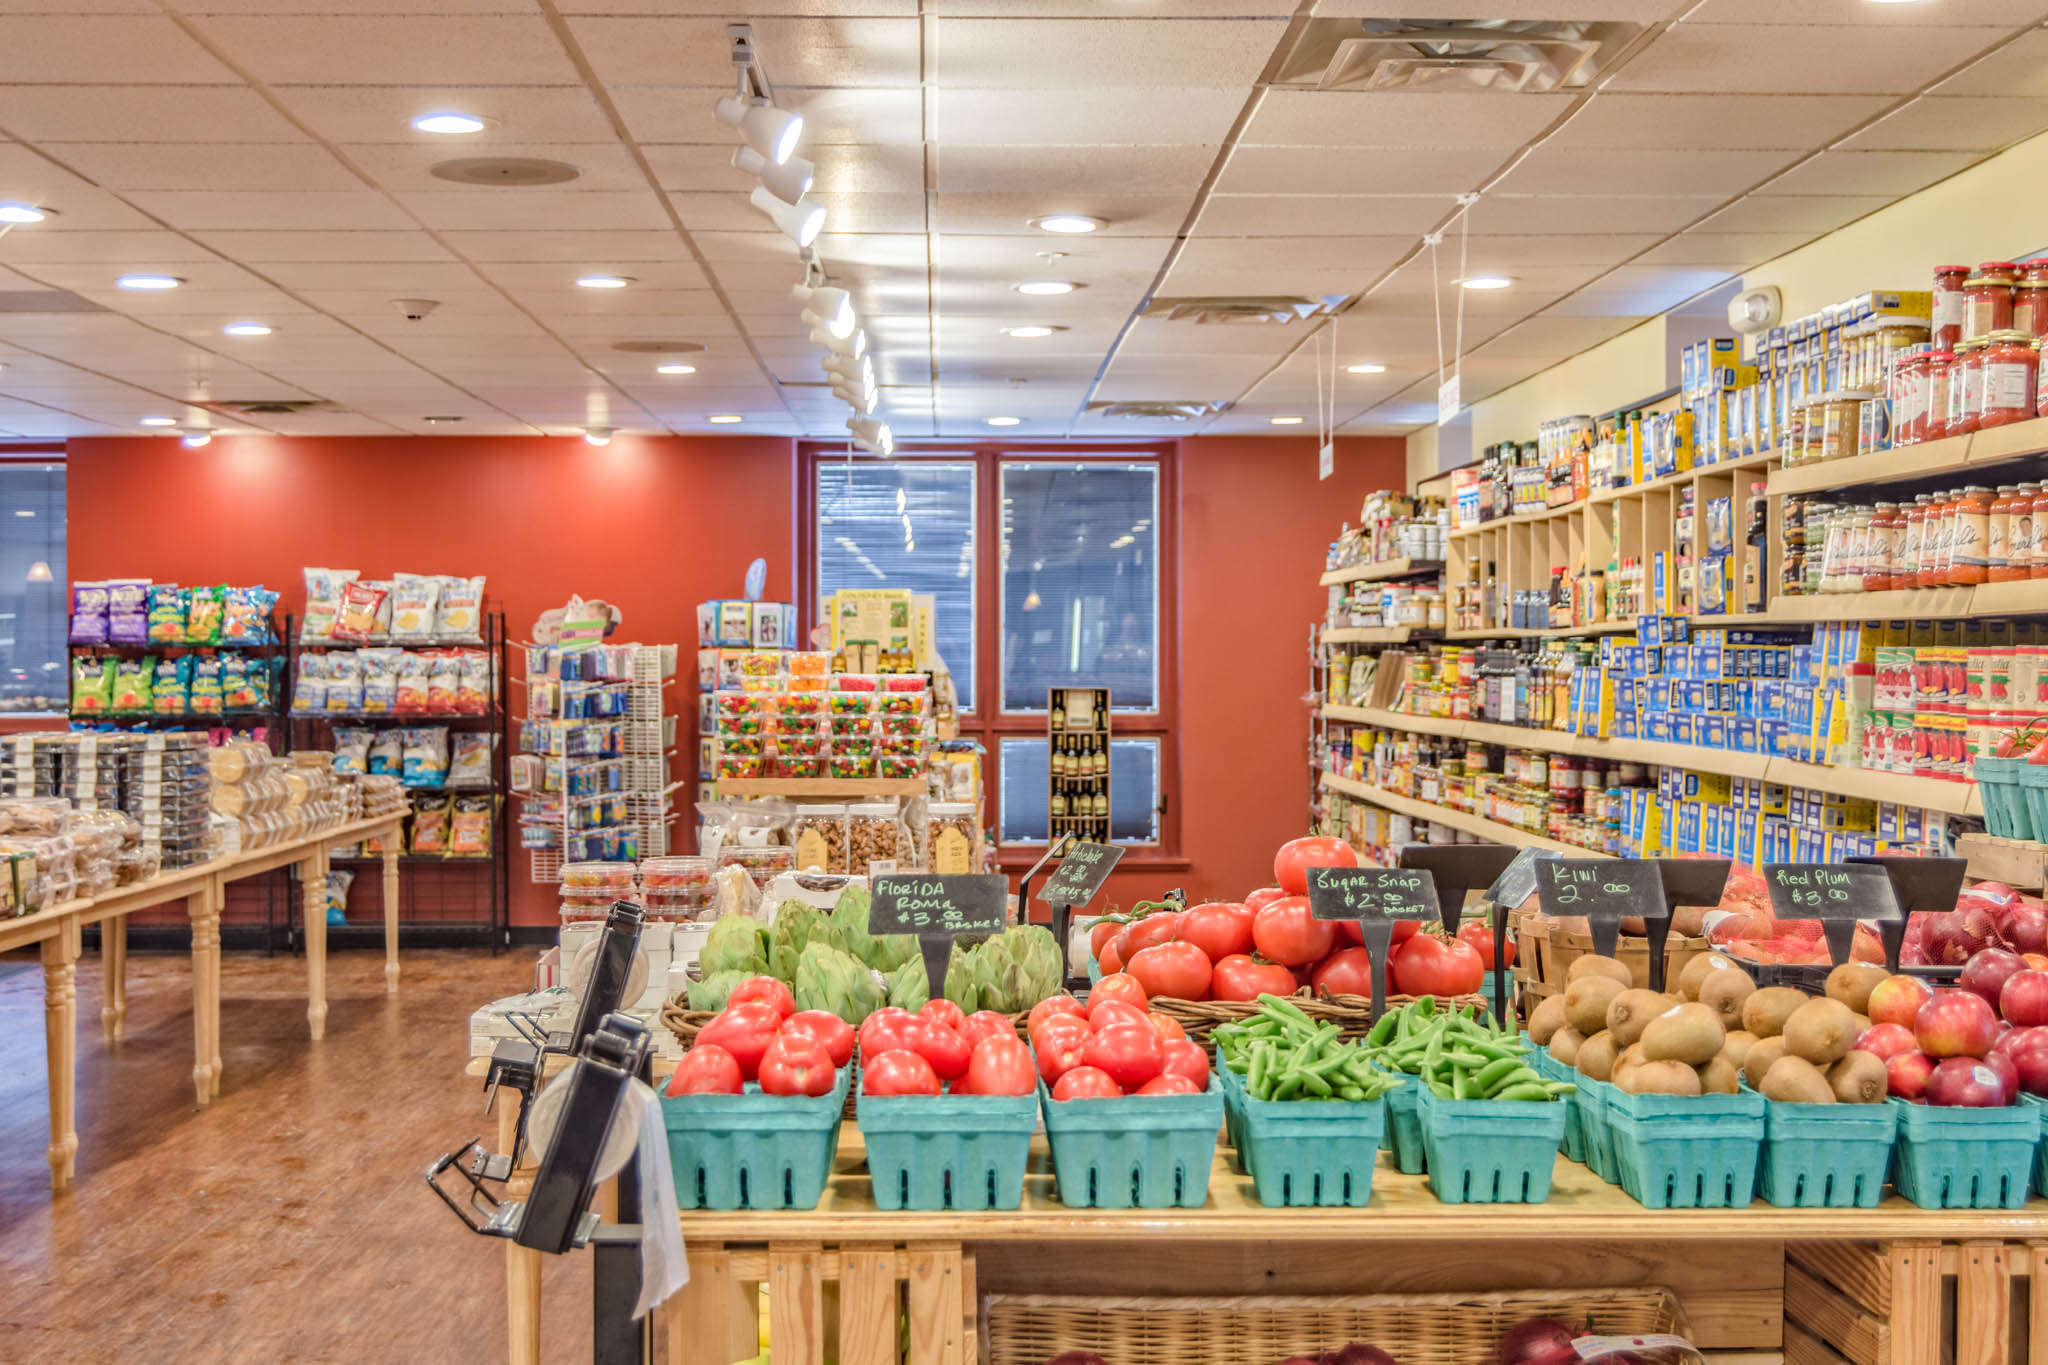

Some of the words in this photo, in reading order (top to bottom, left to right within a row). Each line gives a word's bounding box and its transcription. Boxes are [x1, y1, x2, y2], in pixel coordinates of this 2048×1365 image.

[1378, 873, 1421, 892] Snap
[1776, 869, 1808, 886] Red
[1815, 869, 1851, 886] Plum
